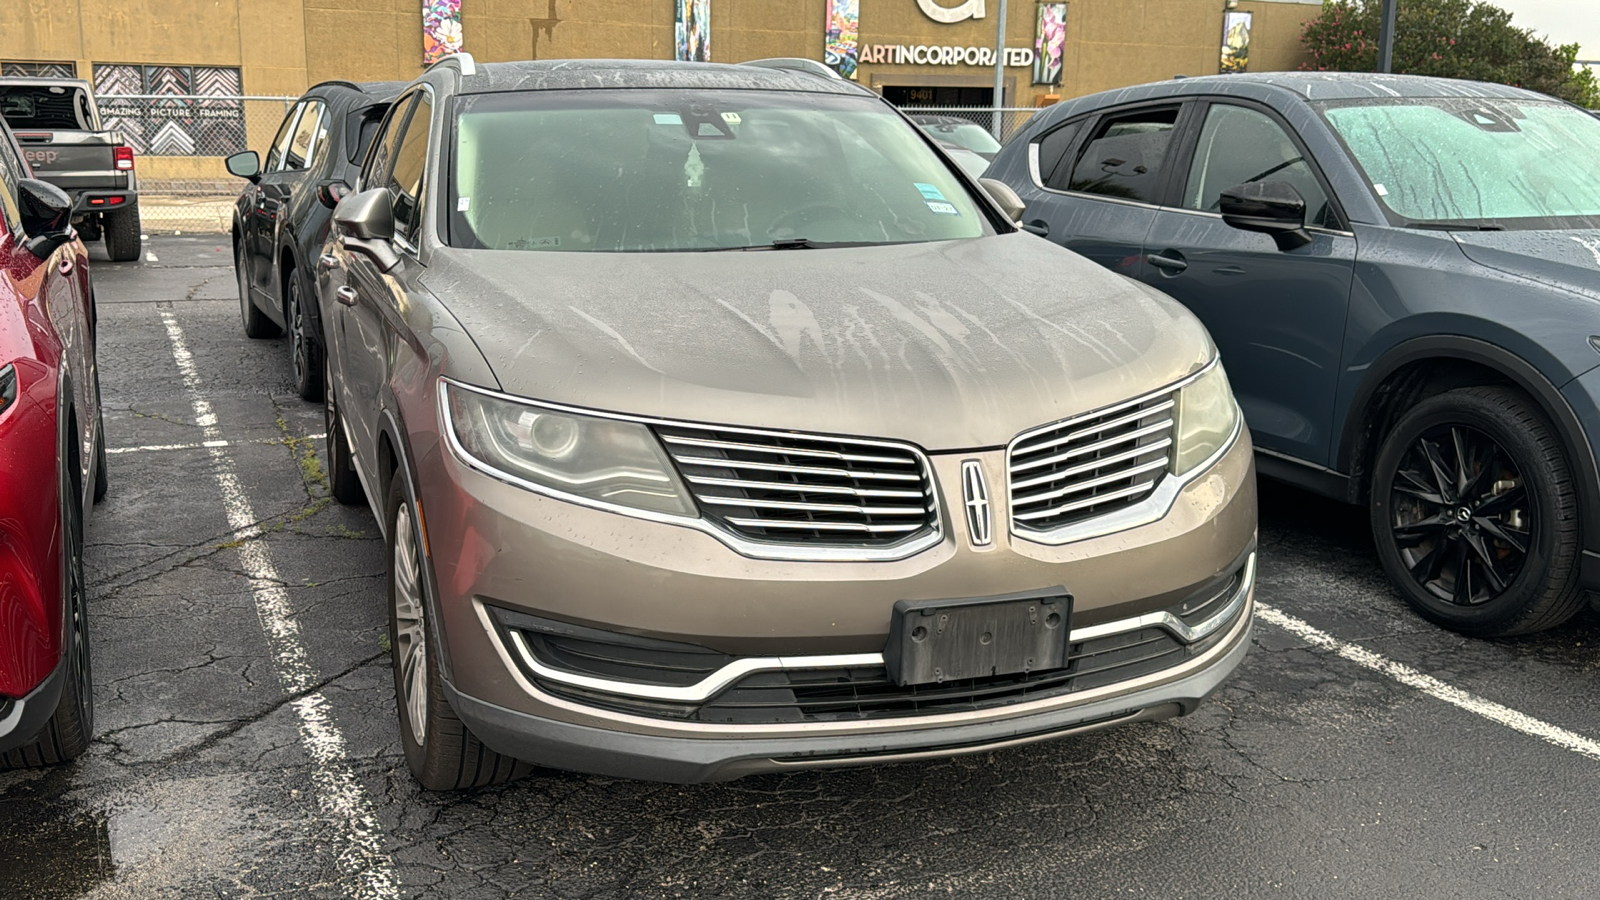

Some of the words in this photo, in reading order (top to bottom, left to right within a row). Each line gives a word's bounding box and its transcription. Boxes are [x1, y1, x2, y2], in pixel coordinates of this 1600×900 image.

[910, 89, 933, 100] 9401
[151, 108, 190, 117] PICTURE
[200, 109, 239, 118] FRAMING
[24, 149, 58, 164] eep
